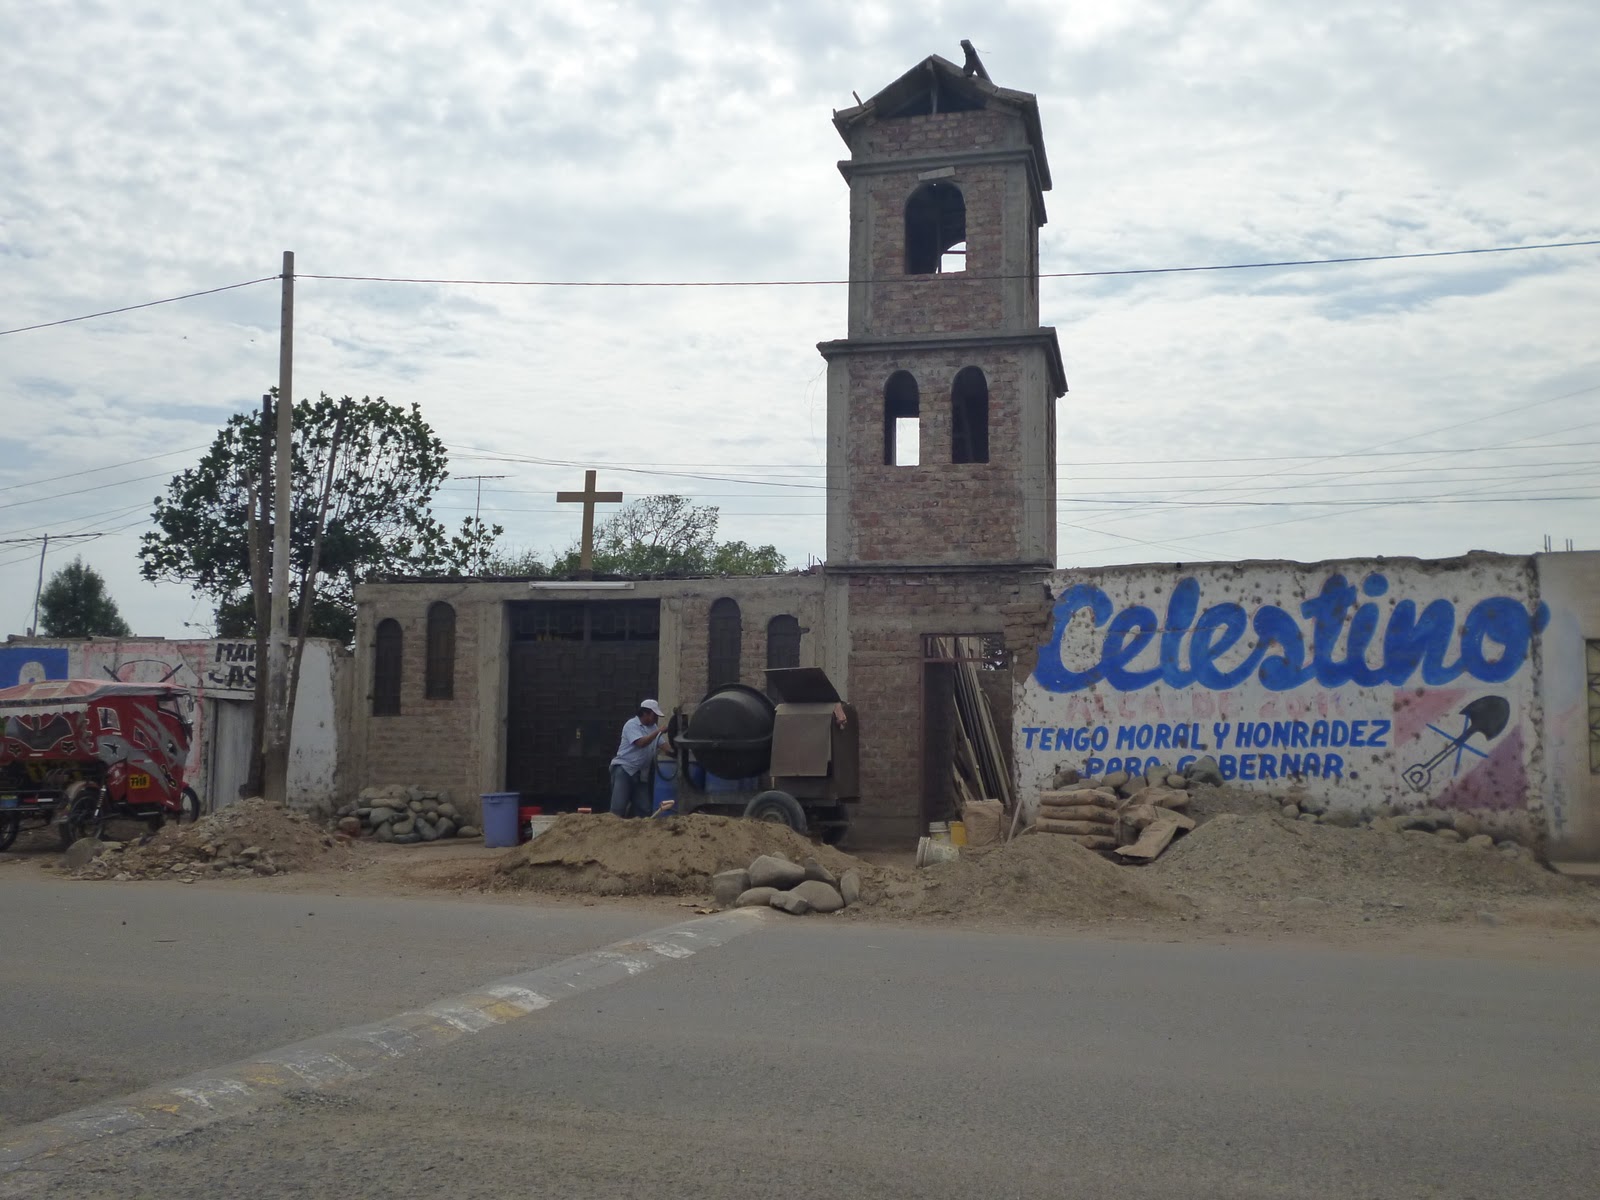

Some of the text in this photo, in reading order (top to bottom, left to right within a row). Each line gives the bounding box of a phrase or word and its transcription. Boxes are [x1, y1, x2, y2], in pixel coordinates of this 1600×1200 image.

[1033, 572, 1551, 694] Celestino
[1021, 719, 1391, 752] TENGO MORAL Y HONRADEZ
